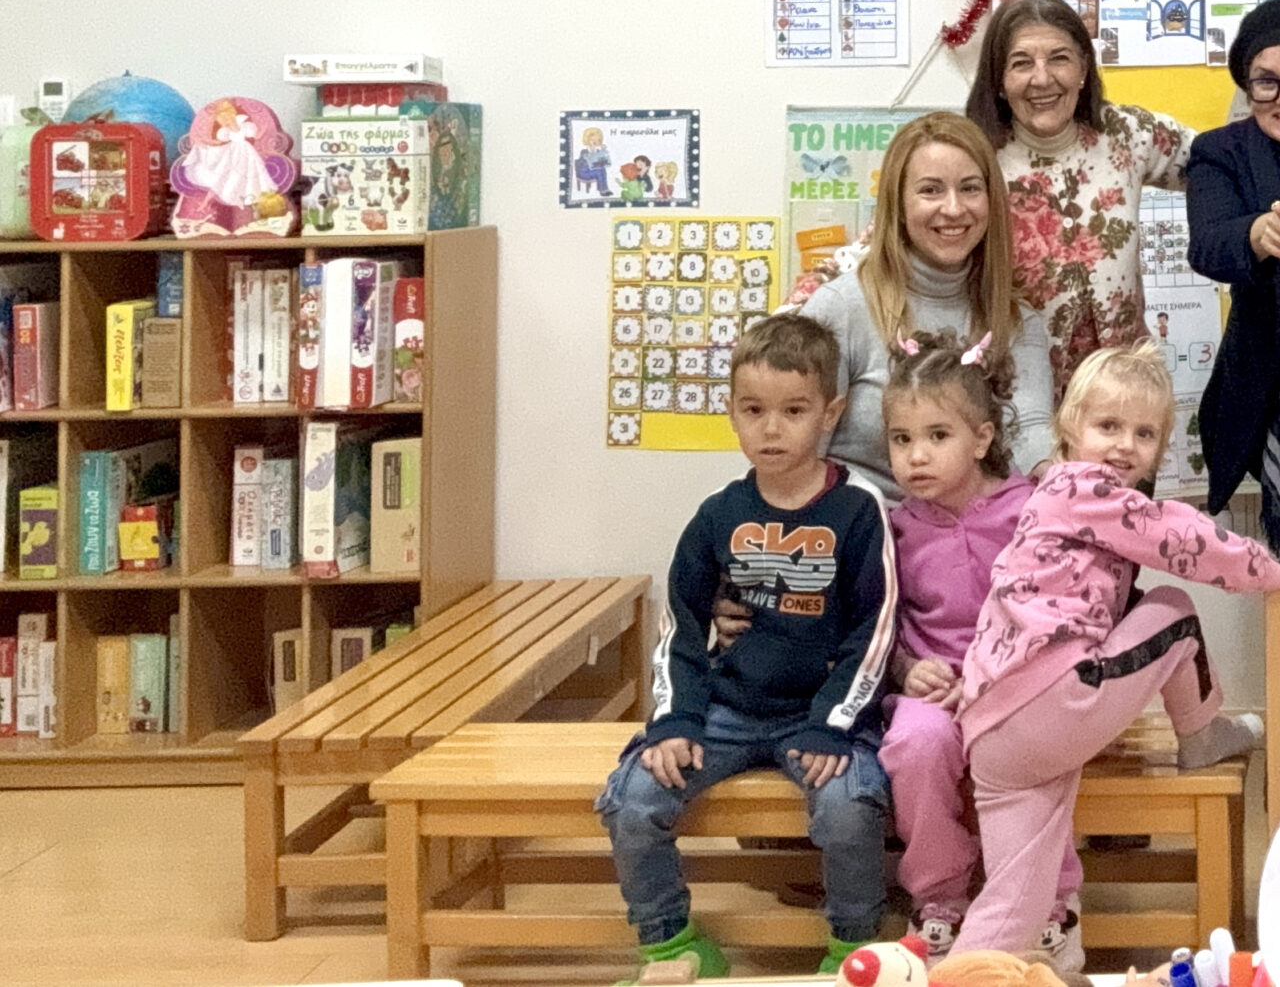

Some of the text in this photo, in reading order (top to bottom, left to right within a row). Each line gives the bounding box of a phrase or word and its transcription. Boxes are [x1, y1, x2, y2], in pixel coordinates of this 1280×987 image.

[305, 126, 410, 143] Ζώα της φάρμας
[788, 123, 904, 151] ΤΟ ΗΜΕ
[790, 179, 859, 200] ΜΕΡΕΣ
[348, 195, 354, 206] 6
[657, 230, 663, 240] 2
[690, 230, 697, 240] 3
[723, 230, 730, 240] 4
[756, 230, 764, 240] 5
[625, 262, 631, 272] 6
[657, 261, 663, 270] 7
[689, 261, 696, 271] 8
[721, 264, 727, 274] 9
[750, 268, 760, 278] 10
[655, 295, 663, 305] 12
[686, 295, 694, 305] 13
[719, 295, 728, 305] 14
[749, 293, 757, 302] 15
[1170, 302, 1202, 311] ΣΗΜΕΡΑ
[623, 325, 631, 334] 16
[654, 324, 663, 333] 17
[685, 326, 694, 336] 18
[719, 325, 728, 335] 19
[1198, 344, 1212, 363] 3
[652, 358, 664, 368] 22
[685, 358, 698, 368] 23
[619, 388, 632, 398] 26
[651, 390, 664, 400] 27
[685, 392, 697, 402] 28
[619, 423, 629, 433] 31
[740, 588, 822, 612] BRAVE ONES
